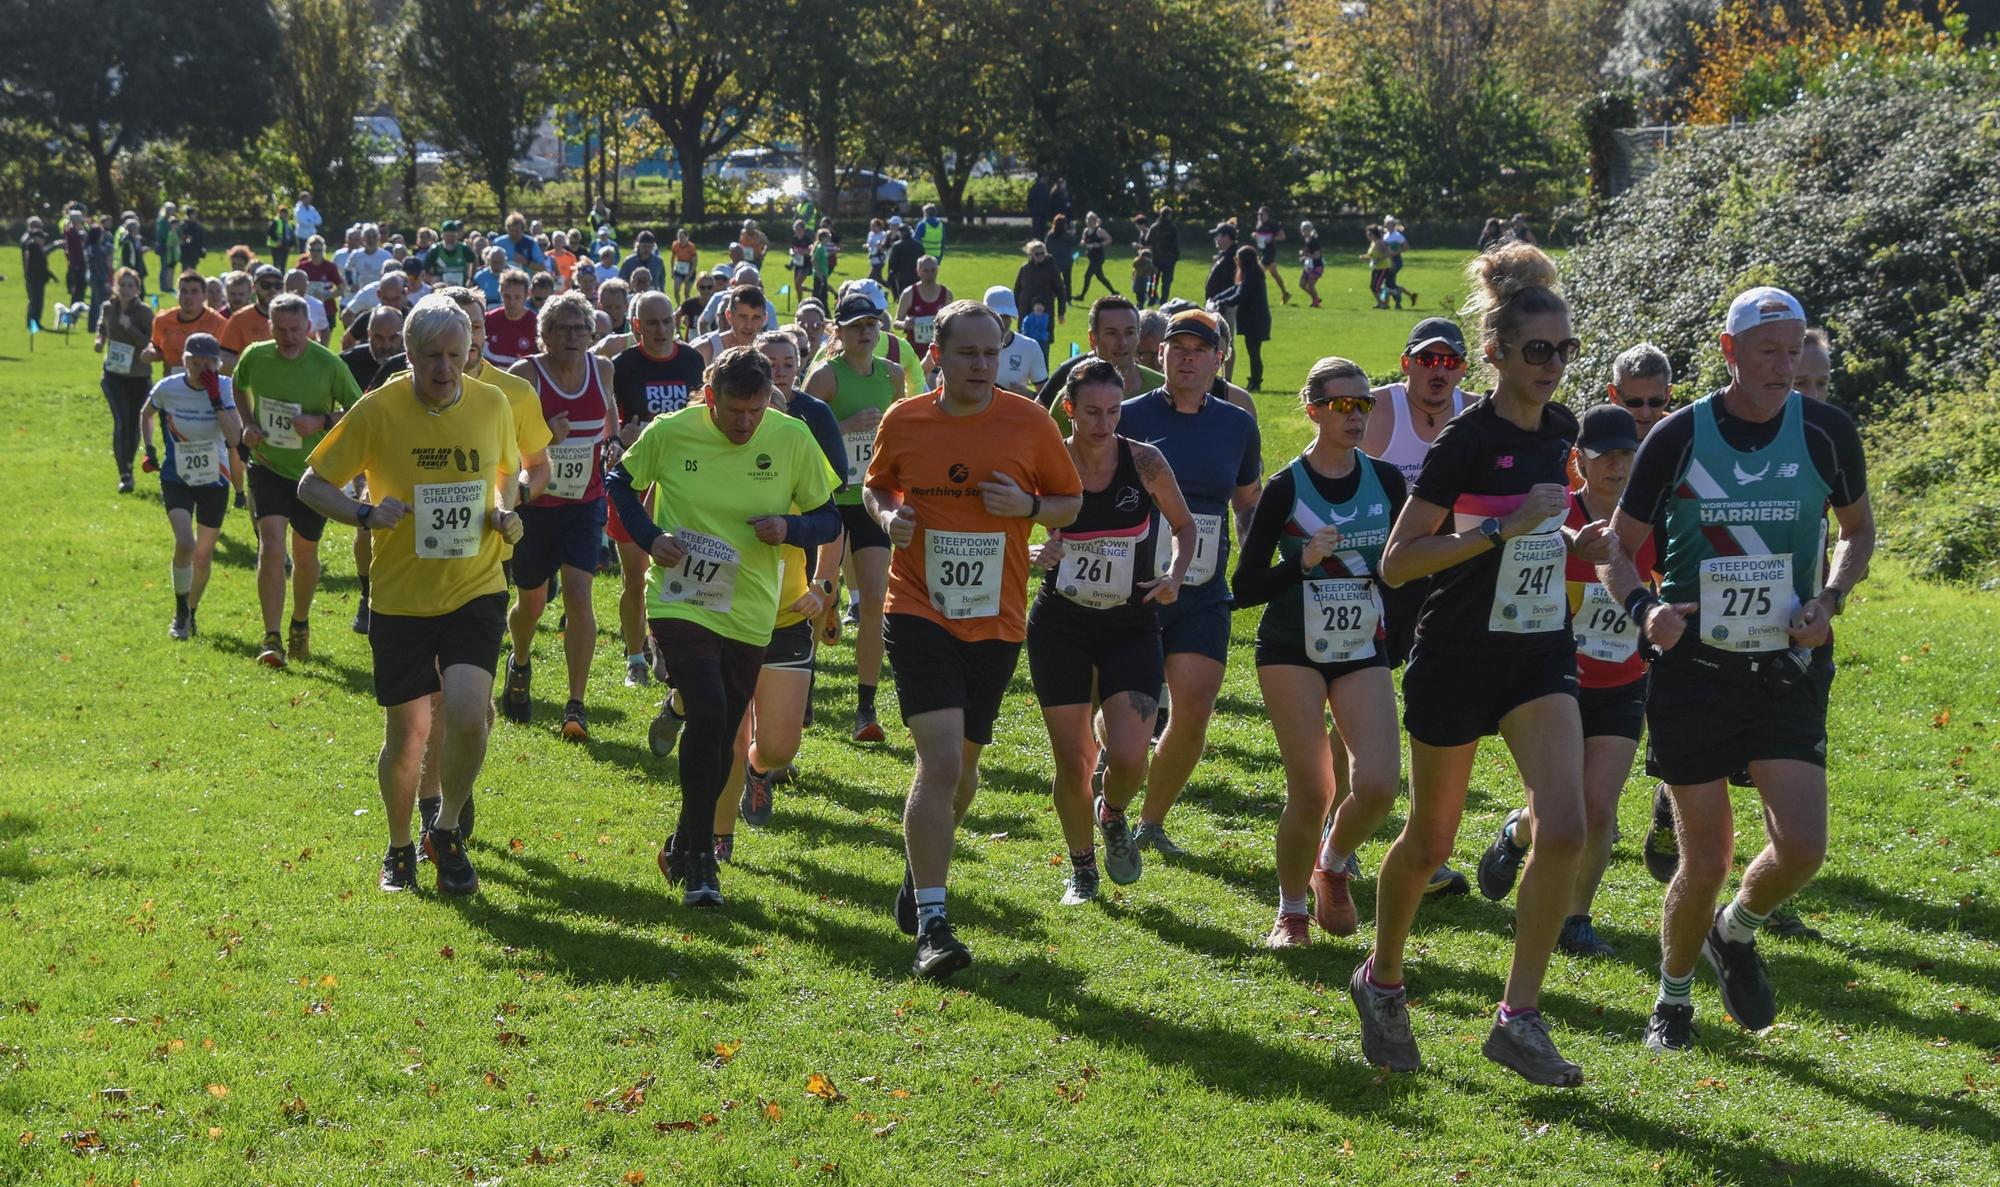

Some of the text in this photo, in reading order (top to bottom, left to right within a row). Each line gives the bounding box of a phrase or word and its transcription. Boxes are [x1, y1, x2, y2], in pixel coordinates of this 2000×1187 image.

[646, 385, 688, 400] RUN
[269, 413, 292, 430] 143
[856, 444, 874, 461] 15
[185, 454, 209, 469] 203
[685, 459, 698, 471] DS
[557, 462, 584, 478] 139
[422, 485, 482, 497] STEEPDOWN
[423, 492, 481, 504] CHALLENGE
[911, 486, 962, 497] Worthing
[1757, 500, 1796, 508] DISTRICT
[431, 506, 472, 530] 349
[1700, 508, 1795, 522] HARRIERS
[932, 535, 1000, 547] STEEPDOWN
[933, 546, 998, 557] CHALLENGE
[683, 555, 721, 583] 147
[1075, 556, 1113, 584] 261
[1709, 559, 1785, 573] STEEPDOWN
[940, 560, 985, 587] 302
[1514, 564, 1555, 596] 247
[1711, 570, 1785, 583] CHALLENGE
[695, 588, 724, 598] Brewers
[962, 594, 991, 604] Brewers
[1092, 590, 1121, 600] Brewers
[1313, 592, 1371, 602] CHALLENGE
[1722, 586, 1772, 617] 275
[1323, 605, 1362, 631] 282
[1589, 608, 1628, 634] 196
[1748, 626, 1780, 636] Brewers
